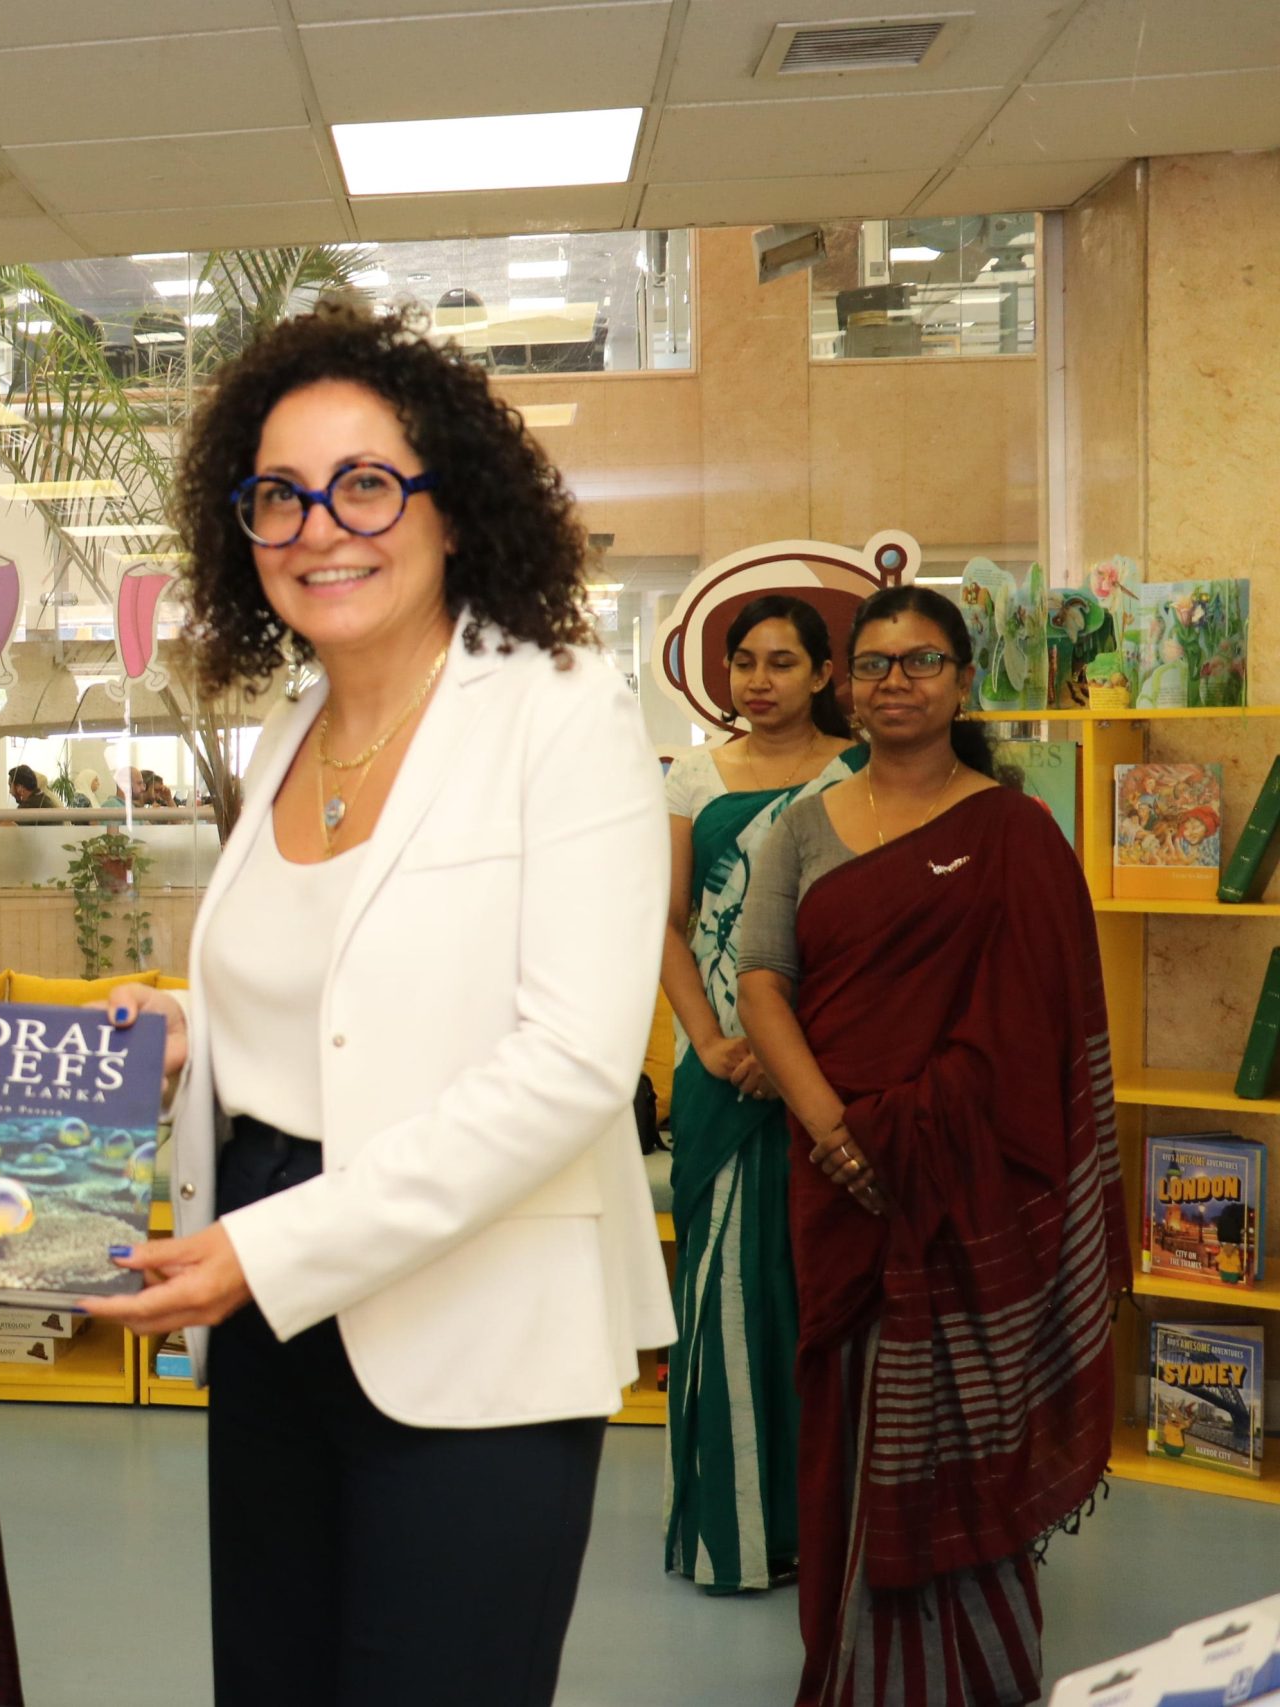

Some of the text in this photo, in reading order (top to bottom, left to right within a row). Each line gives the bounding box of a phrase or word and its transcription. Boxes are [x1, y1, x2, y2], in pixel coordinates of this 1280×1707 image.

[24, 1085, 106, 1103] LANKA
[1175, 1152, 1206, 1167] AWESOME
[1158, 1175, 1240, 1203] LONDON
[1175, 1249, 1187, 1258] CITY
[1180, 1338, 1211, 1354] AWESOME
[1163, 1363, 1246, 1387] SYDNEY
[1218, 1450, 1232, 1461] CITY
